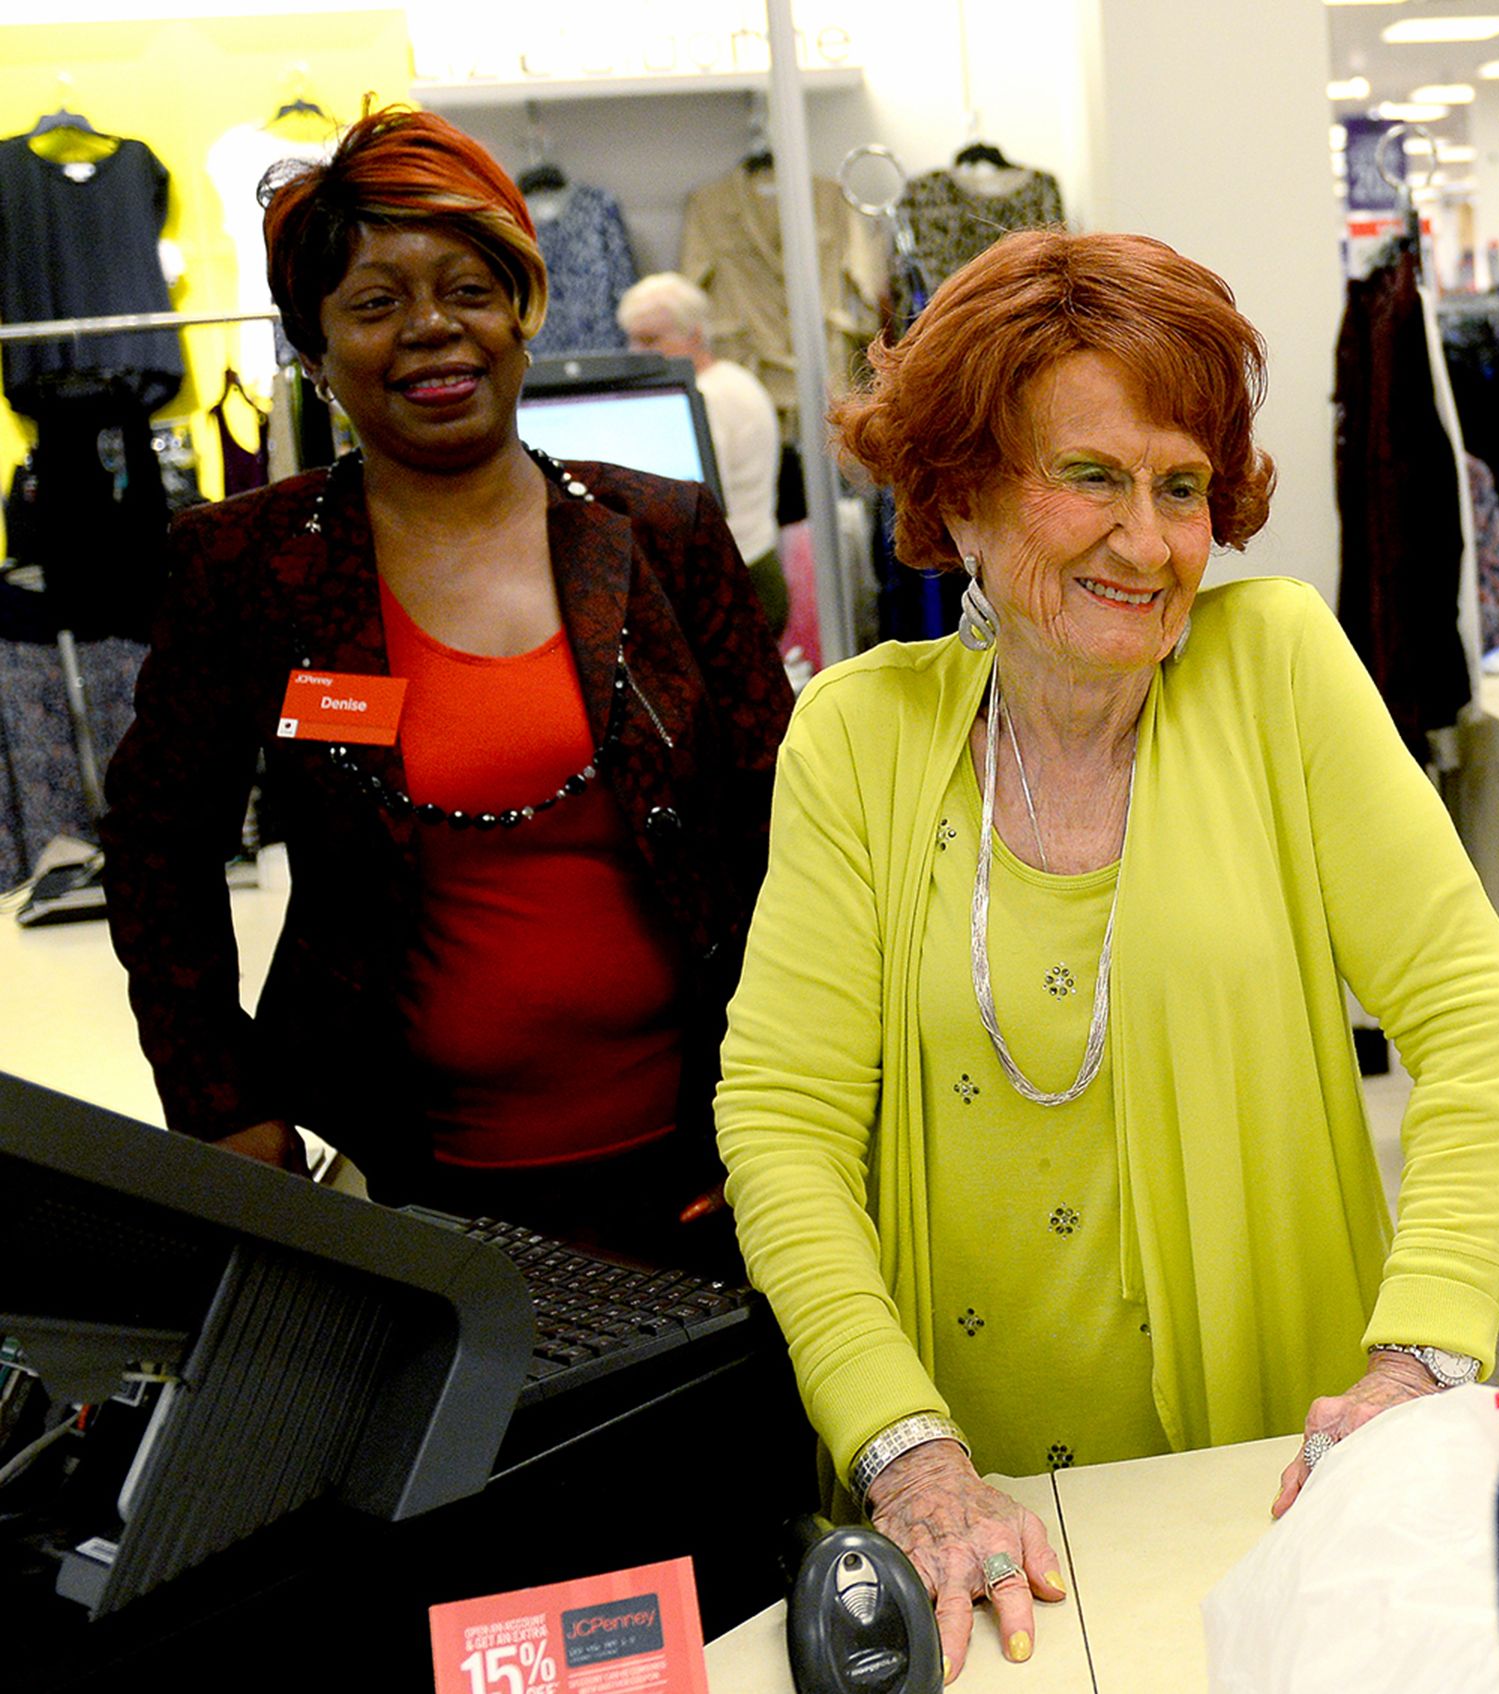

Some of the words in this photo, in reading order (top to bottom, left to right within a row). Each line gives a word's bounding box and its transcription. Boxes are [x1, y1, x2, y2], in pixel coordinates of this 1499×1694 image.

[320, 696, 367, 712] Denise
[566, 1609, 656, 1640] JCPenney
[460, 1639, 556, 1694] 15%
